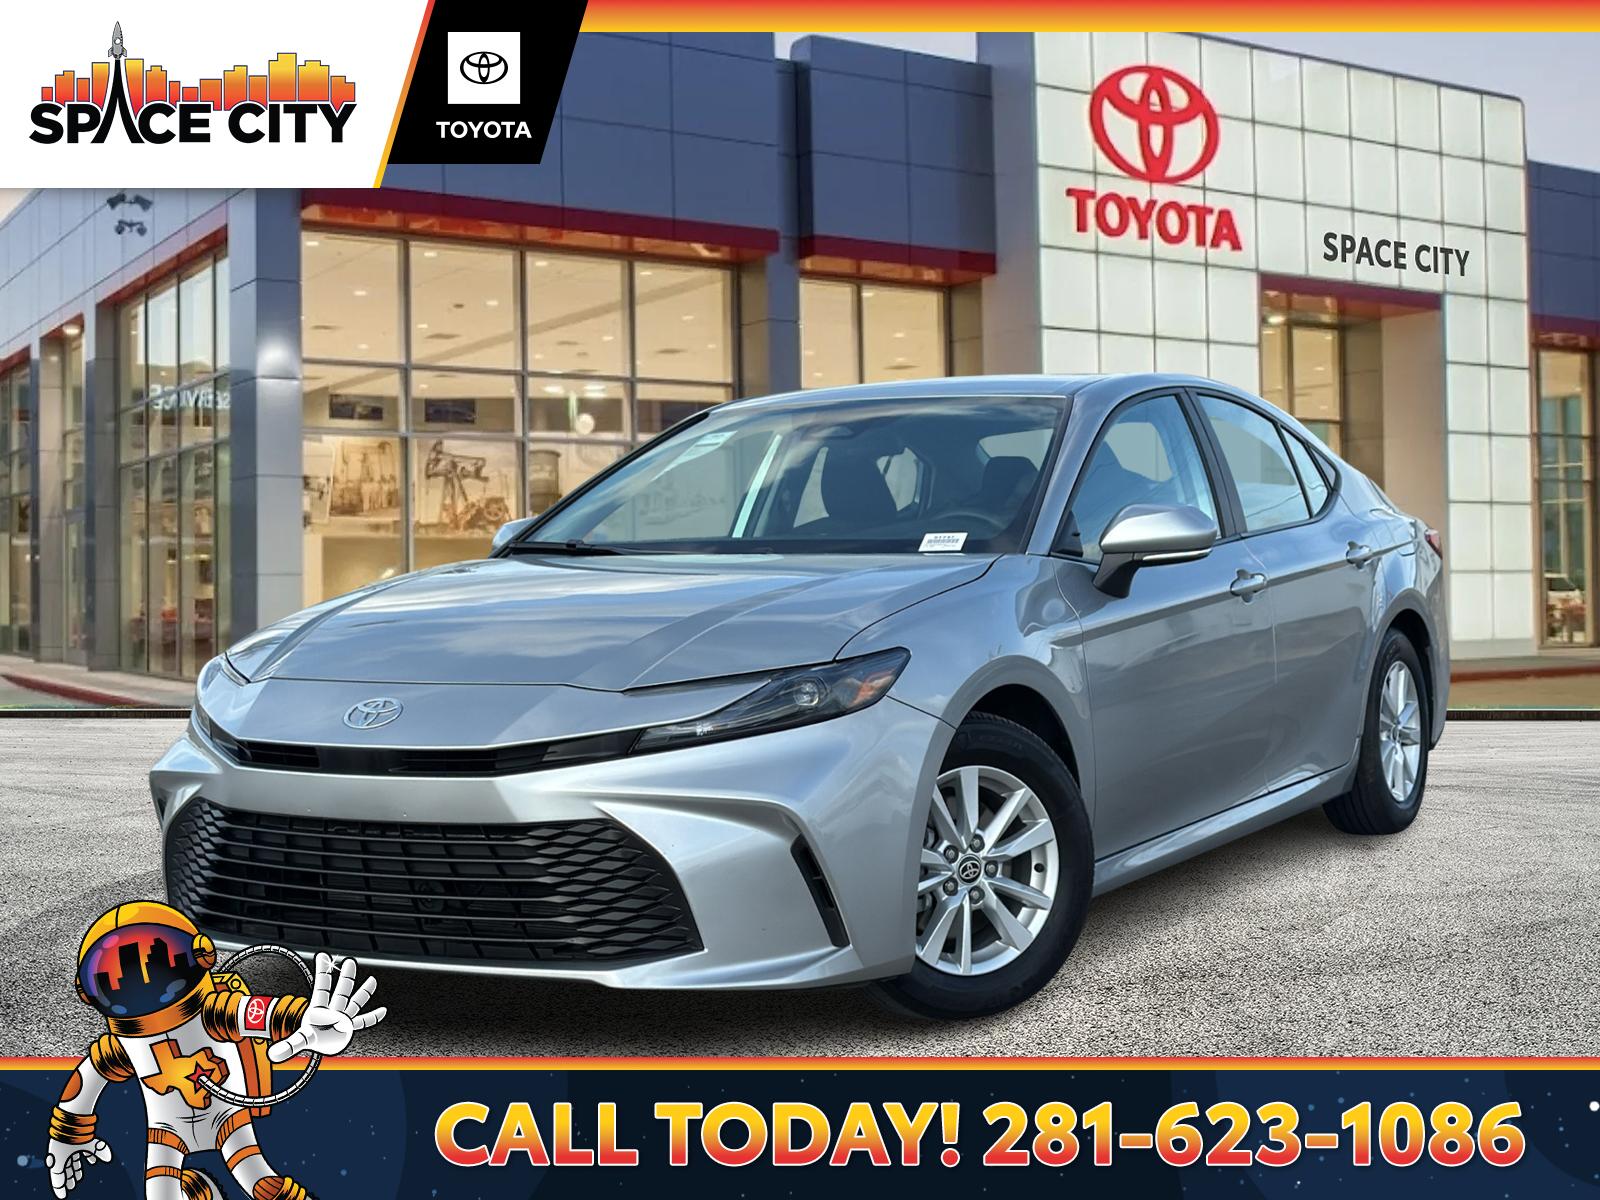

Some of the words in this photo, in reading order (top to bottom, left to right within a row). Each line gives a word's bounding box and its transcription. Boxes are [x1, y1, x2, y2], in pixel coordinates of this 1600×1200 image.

[1065, 186, 1243, 252] TOYOTA
[1322, 231, 1407, 270] SPACE
[1414, 244, 1471, 277] CITY
